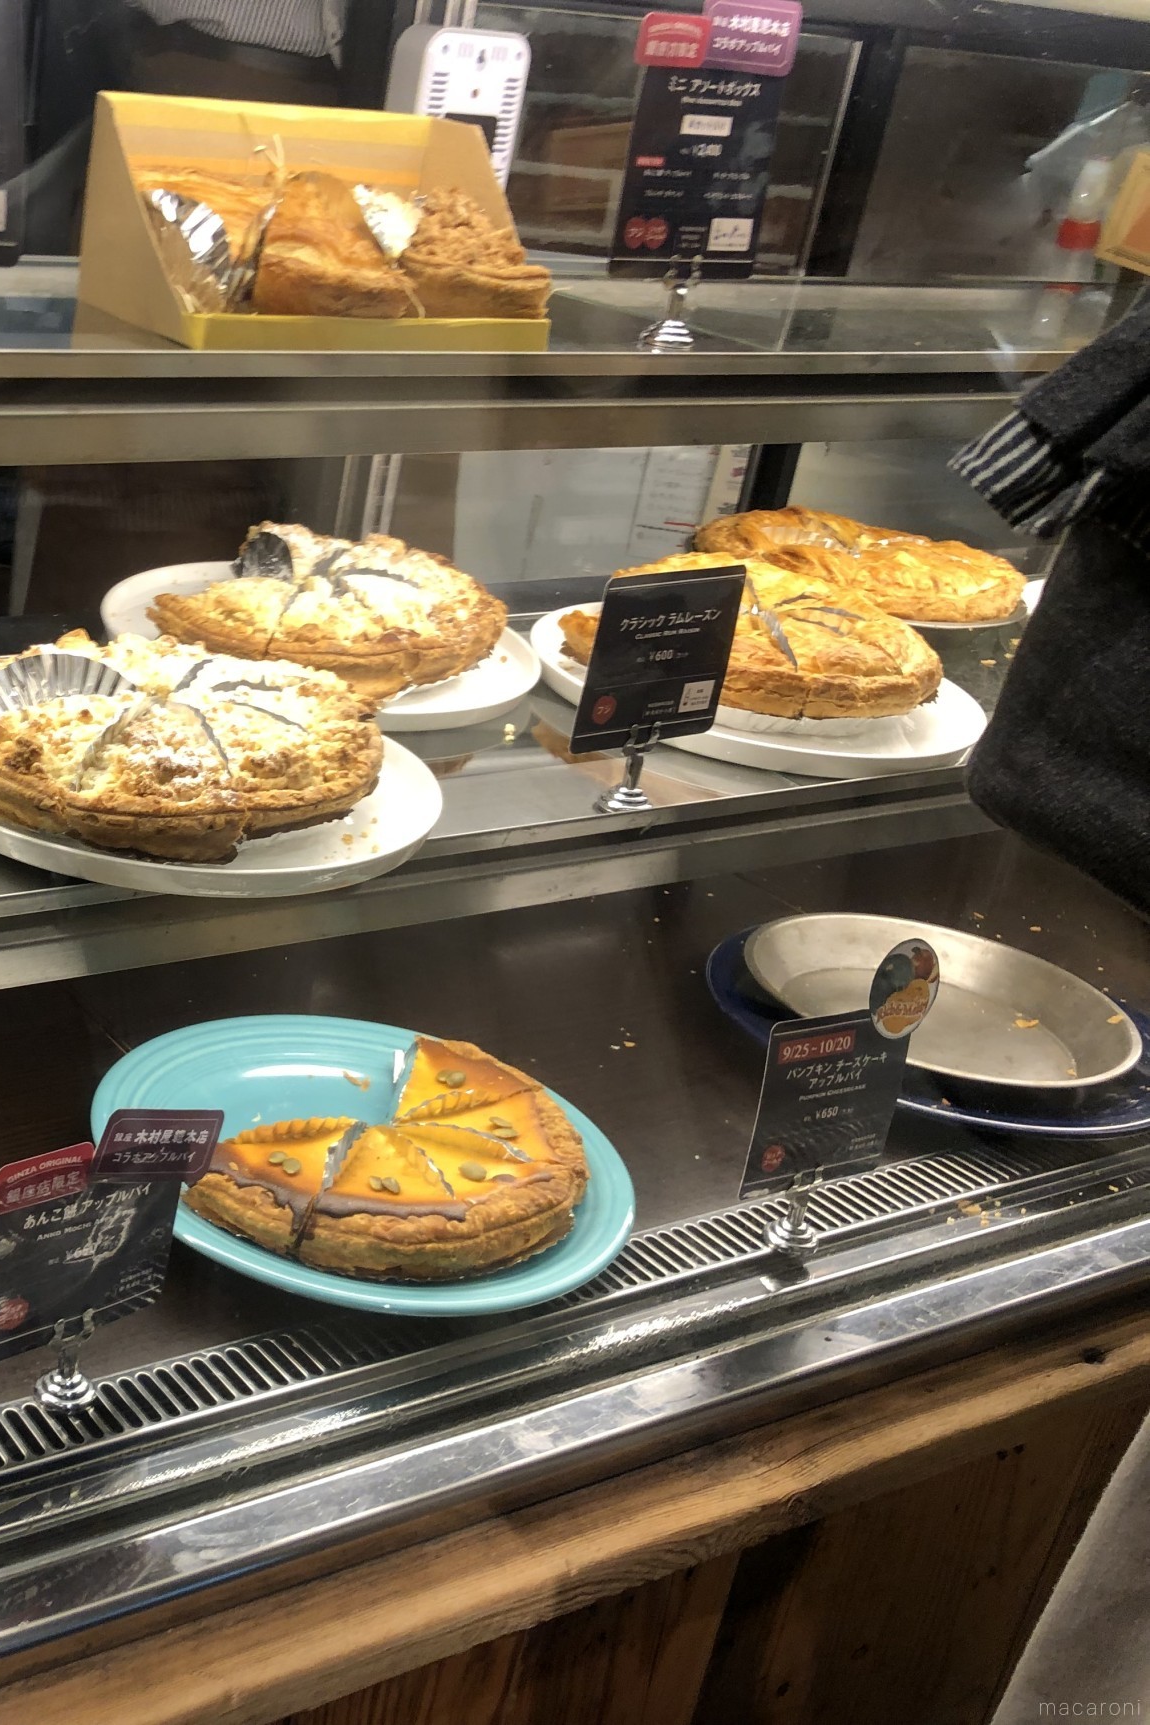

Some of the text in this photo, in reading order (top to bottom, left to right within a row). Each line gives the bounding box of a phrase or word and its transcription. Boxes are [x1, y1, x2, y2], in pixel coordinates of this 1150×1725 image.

[620, 609, 722, 631] クラシック ラムレーズン
[786, 1051, 887, 1079] パンプキン チーズケーキ
[809, 1069, 862, 1089] アップルパイ
[6, 1155, 83, 1184] GINZA ORIGINAL
[6, 1170, 81, 1204] 銀座店限定
